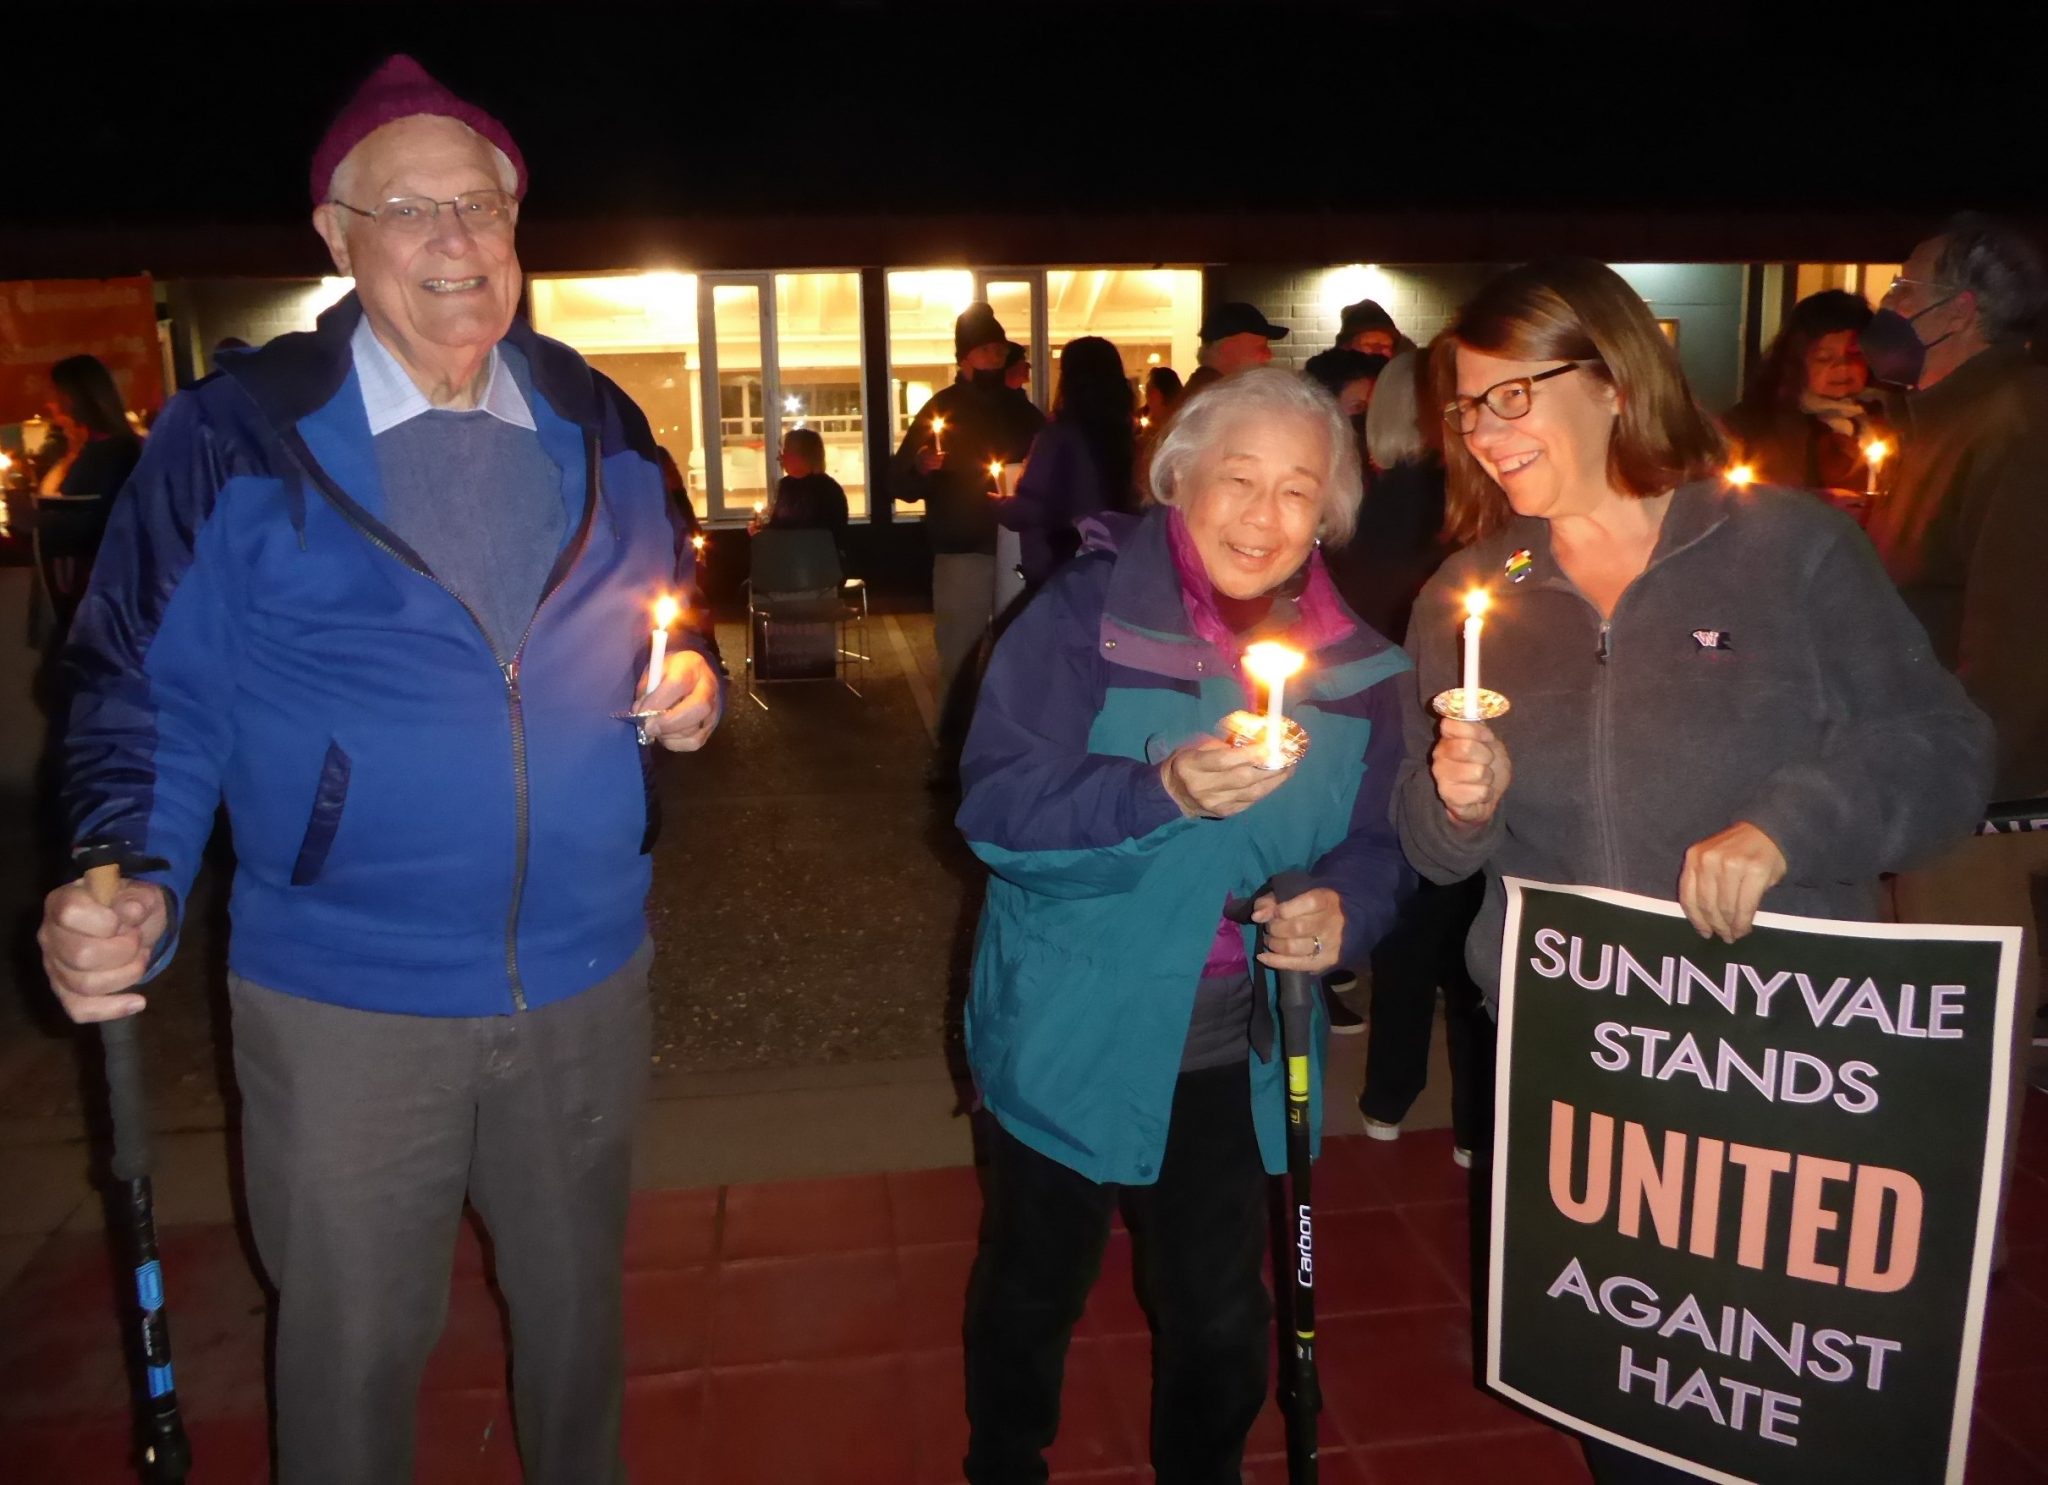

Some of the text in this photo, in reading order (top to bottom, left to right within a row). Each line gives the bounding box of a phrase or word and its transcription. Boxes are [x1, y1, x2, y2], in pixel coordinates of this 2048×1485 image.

[1529, 927, 1967, 1039] SUNNYVALE
[1590, 1021, 1880, 1114] STANDS
[1297, 1204, 1313, 1288] Carbon
[1548, 1099, 1924, 1293] UNITED
[1546, 1256, 1902, 1391] AGAINST
[1618, 1344, 1802, 1447] HATE
